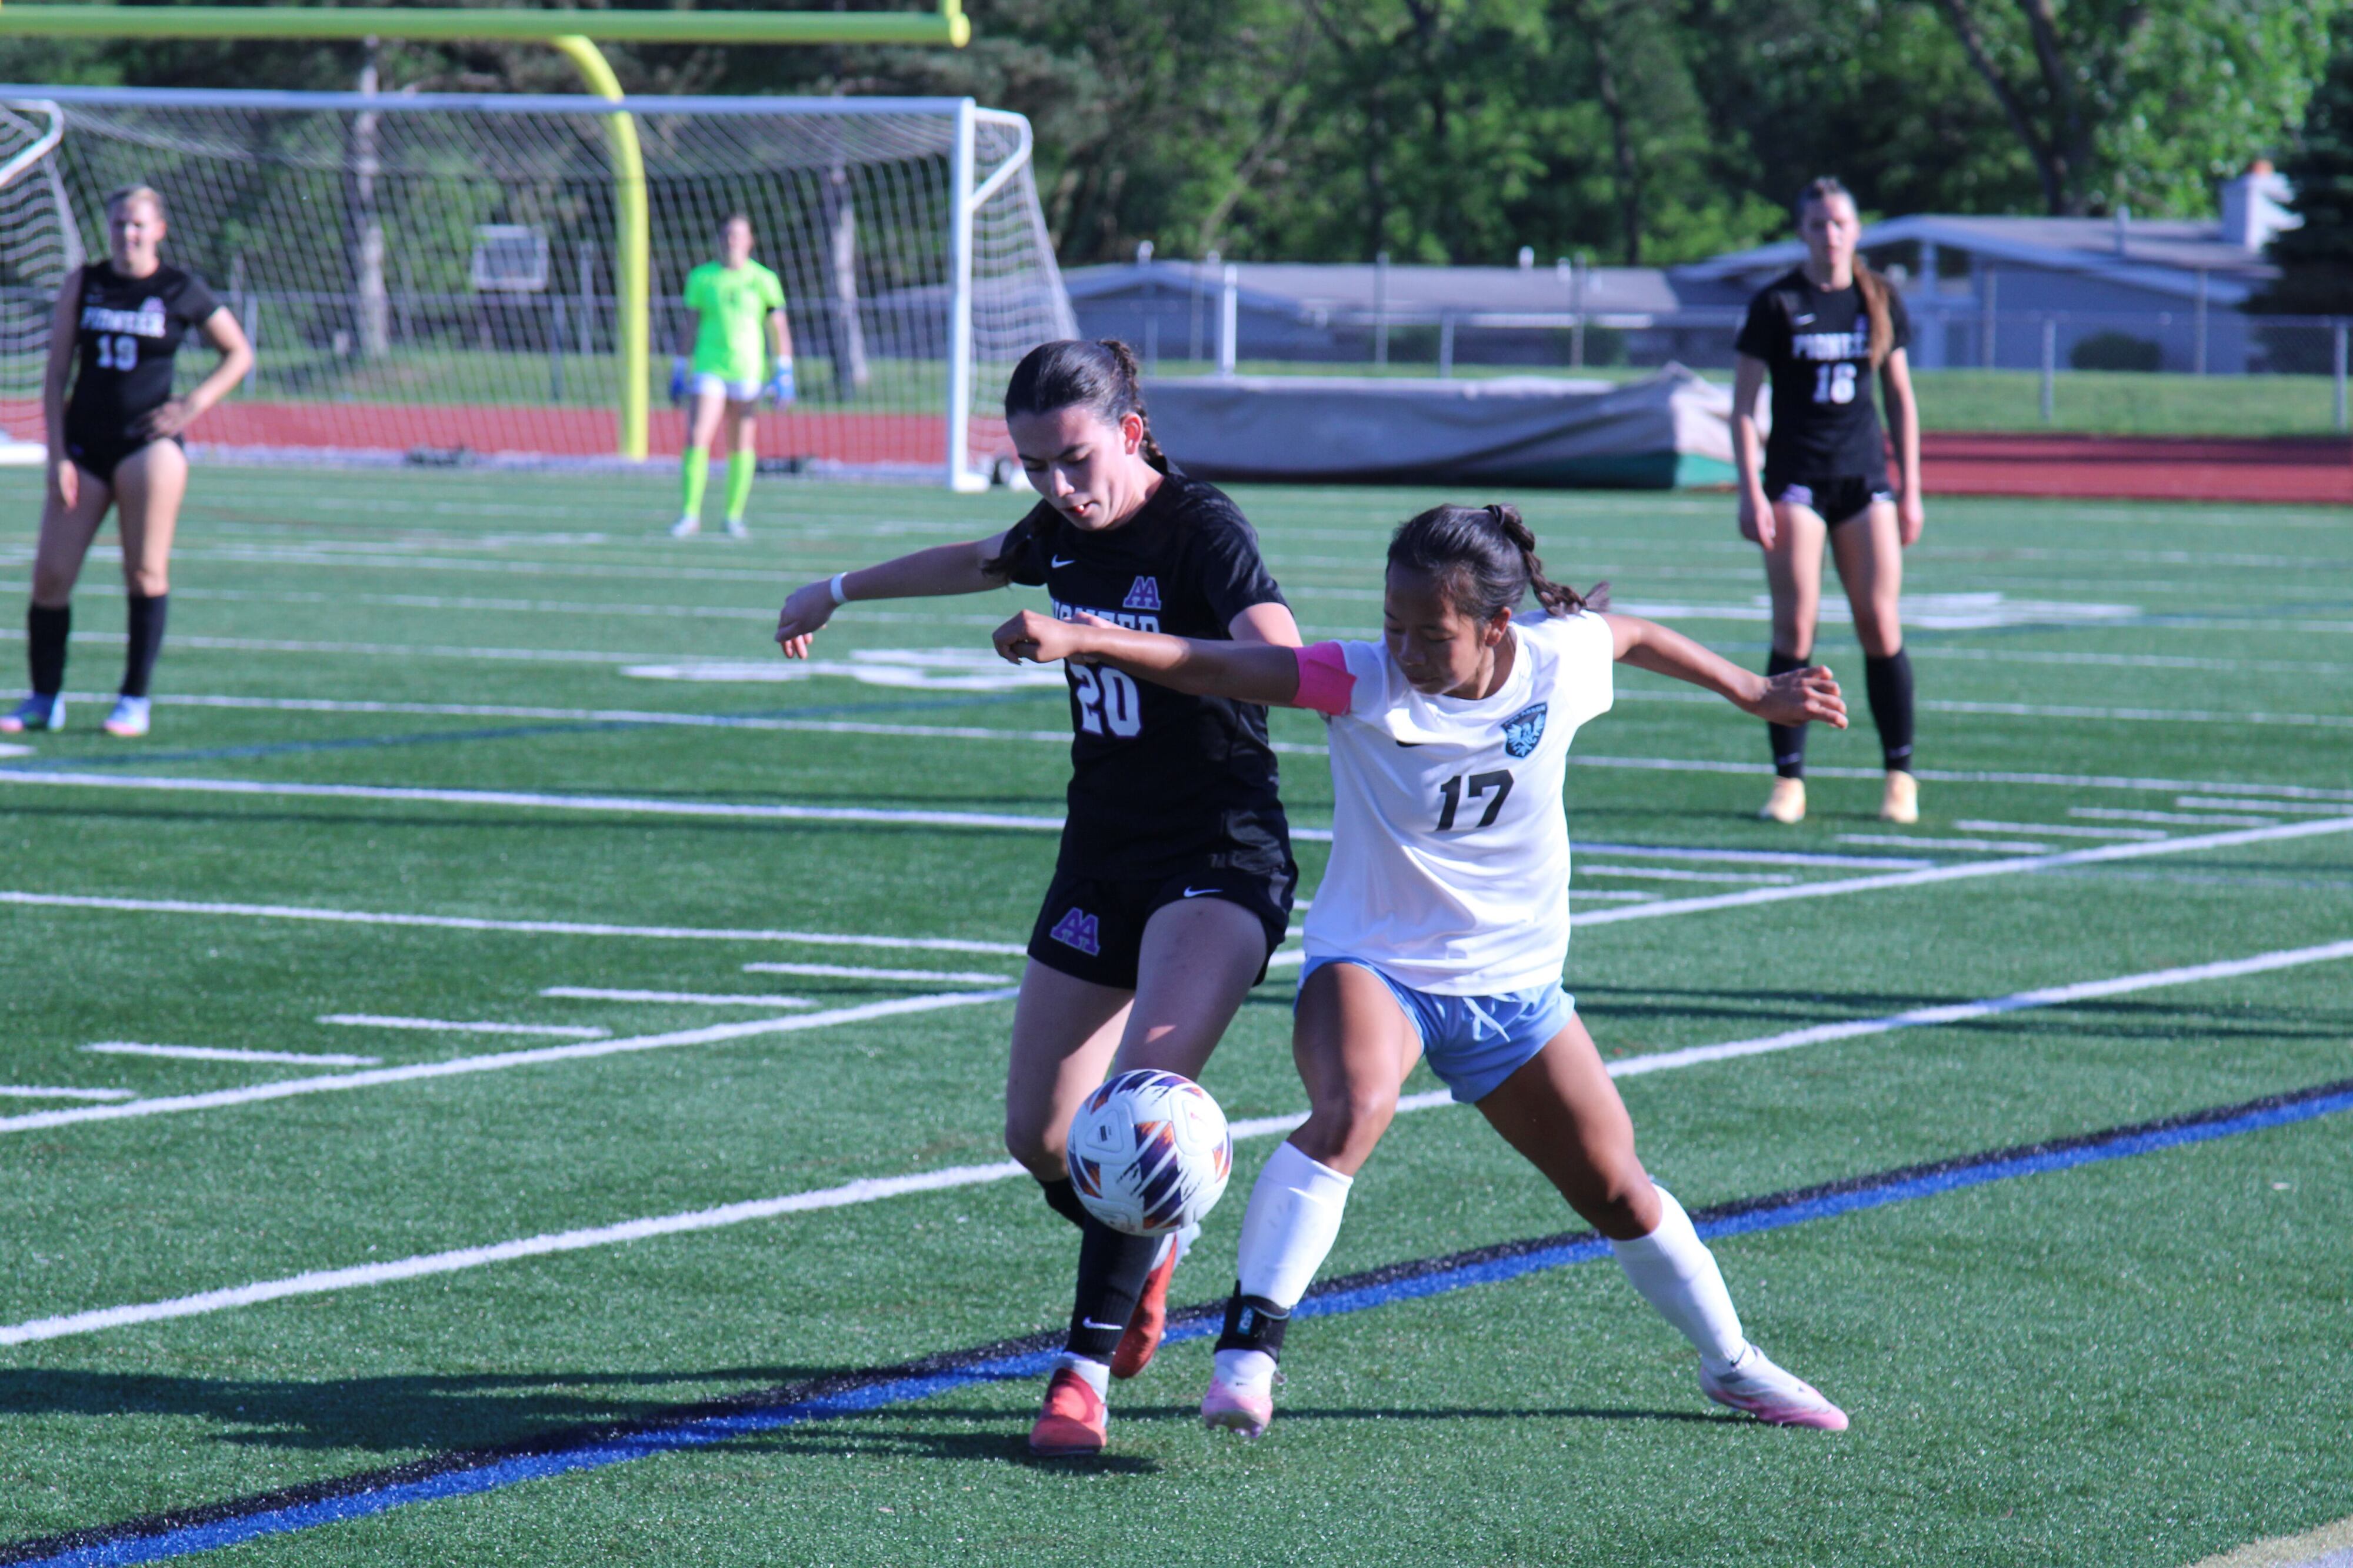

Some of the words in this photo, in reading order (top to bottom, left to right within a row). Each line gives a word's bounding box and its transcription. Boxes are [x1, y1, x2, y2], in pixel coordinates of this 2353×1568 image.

[1792, 333, 1871, 361] PIONEE
[1068, 658, 1143, 739] 20
[1436, 769, 1514, 831] 17
